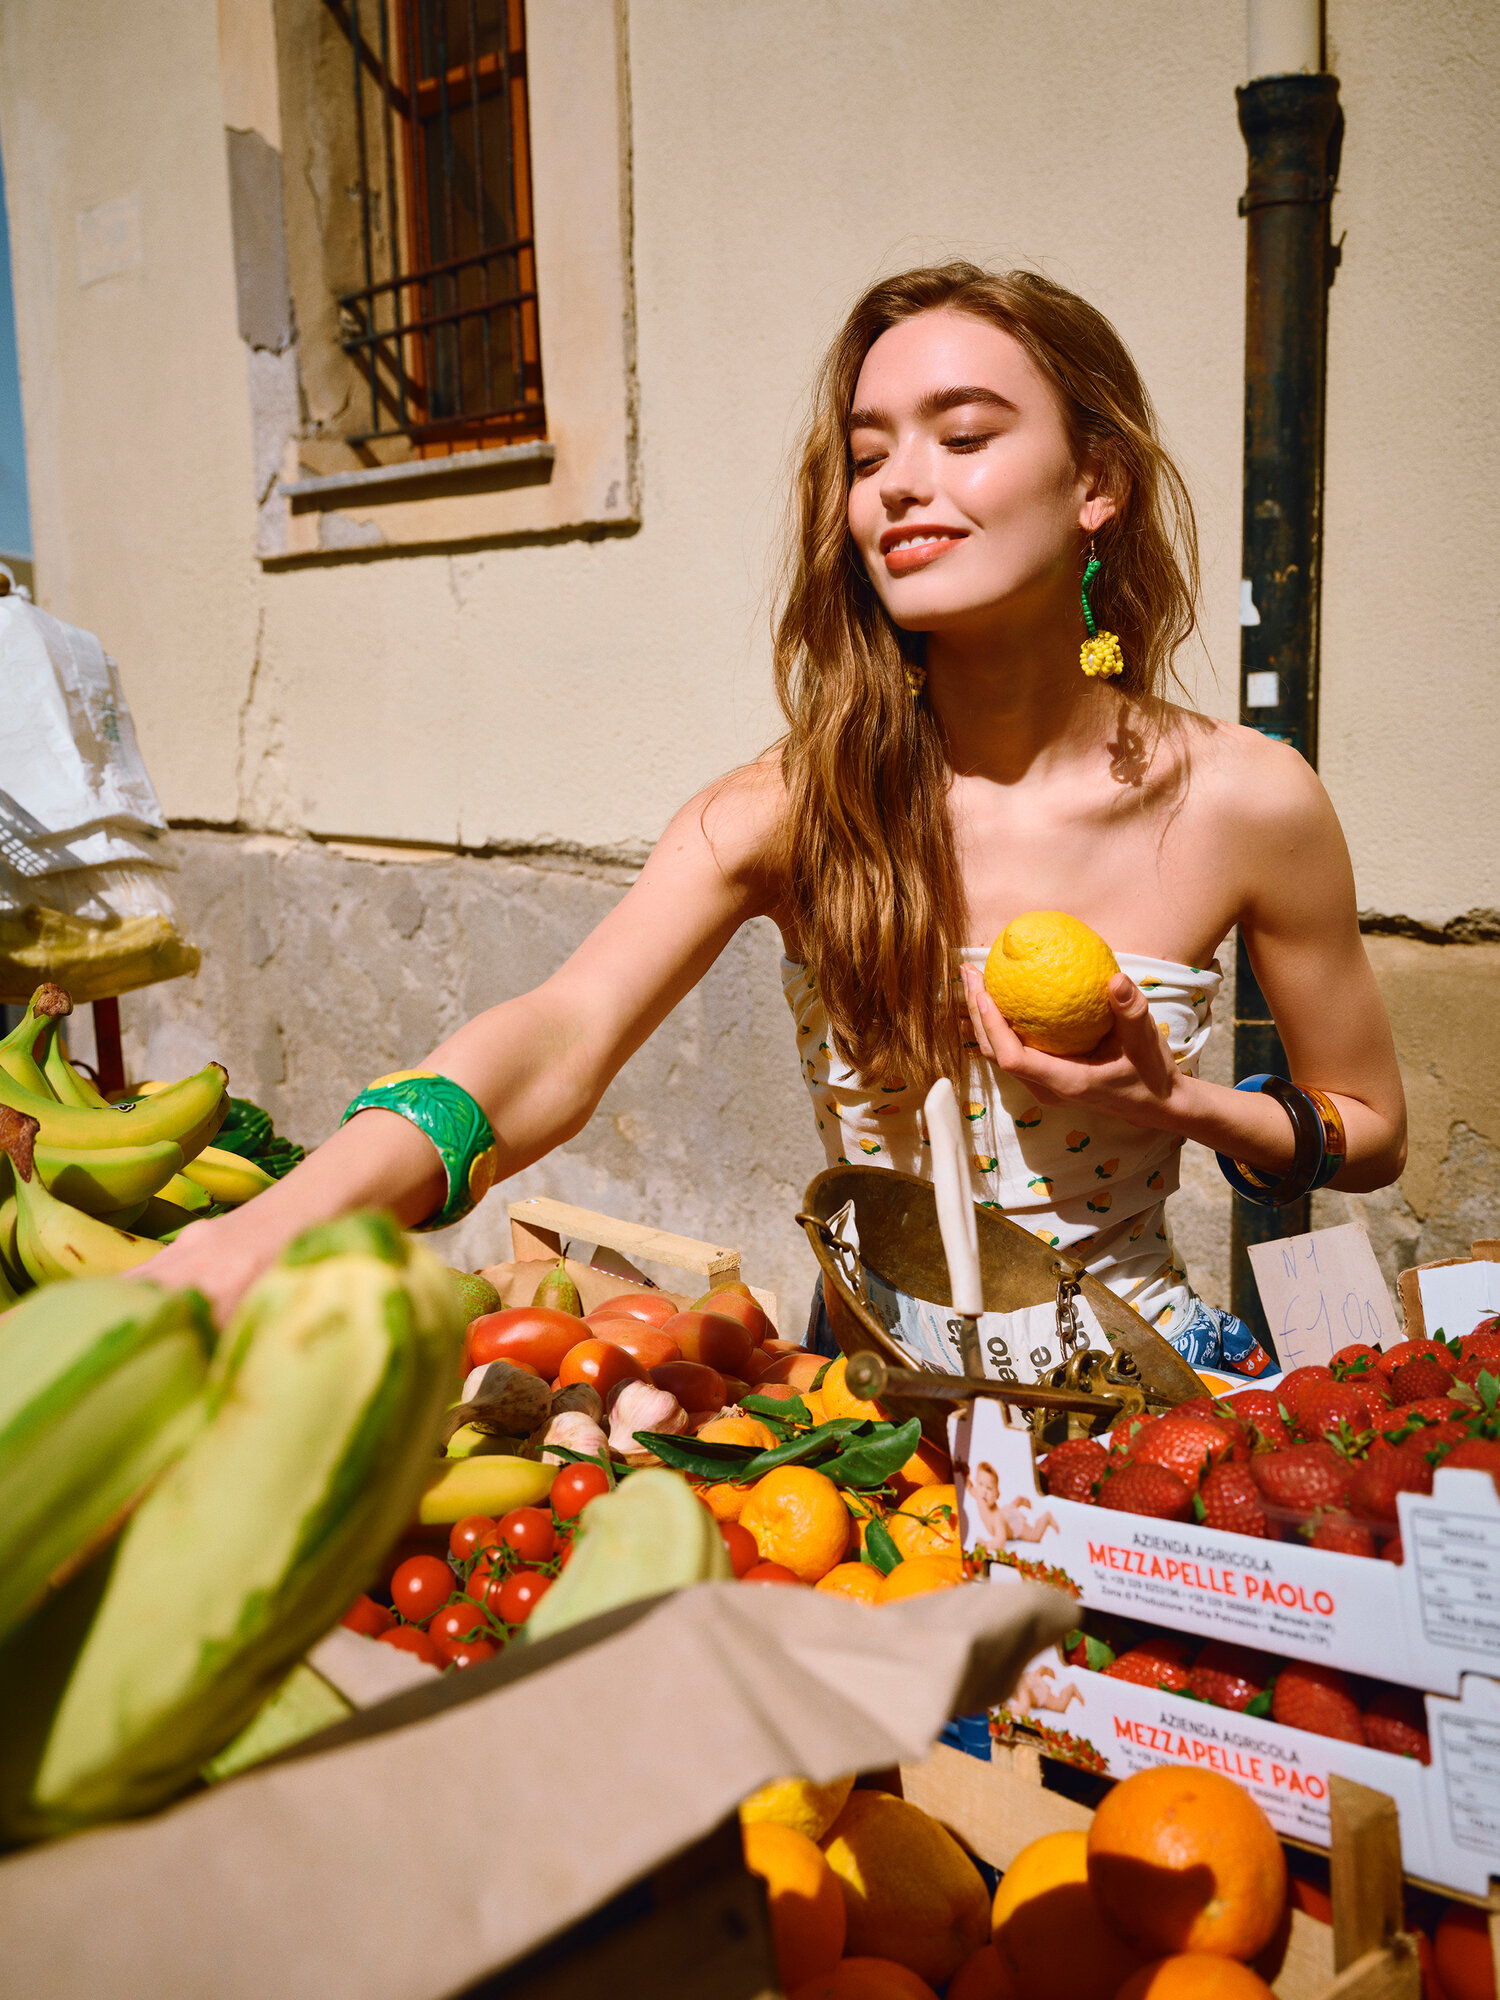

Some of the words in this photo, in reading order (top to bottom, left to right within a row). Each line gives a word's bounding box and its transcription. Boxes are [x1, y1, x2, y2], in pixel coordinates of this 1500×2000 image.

[1087, 1540, 1238, 1597] MEZZAPELLE
[1244, 1574, 1336, 1617] PAOLO
[1133, 1533, 1193, 1555] AZIENDA
[1196, 1546, 1275, 1573] AGRICOLA
[1113, 1715, 1264, 1783] MEZZAPELLE
[1271, 1763, 1328, 1800] PAO
[1160, 1713, 1219, 1739] AZIENDA
[1223, 1731, 1300, 1764] AGRICOLA
